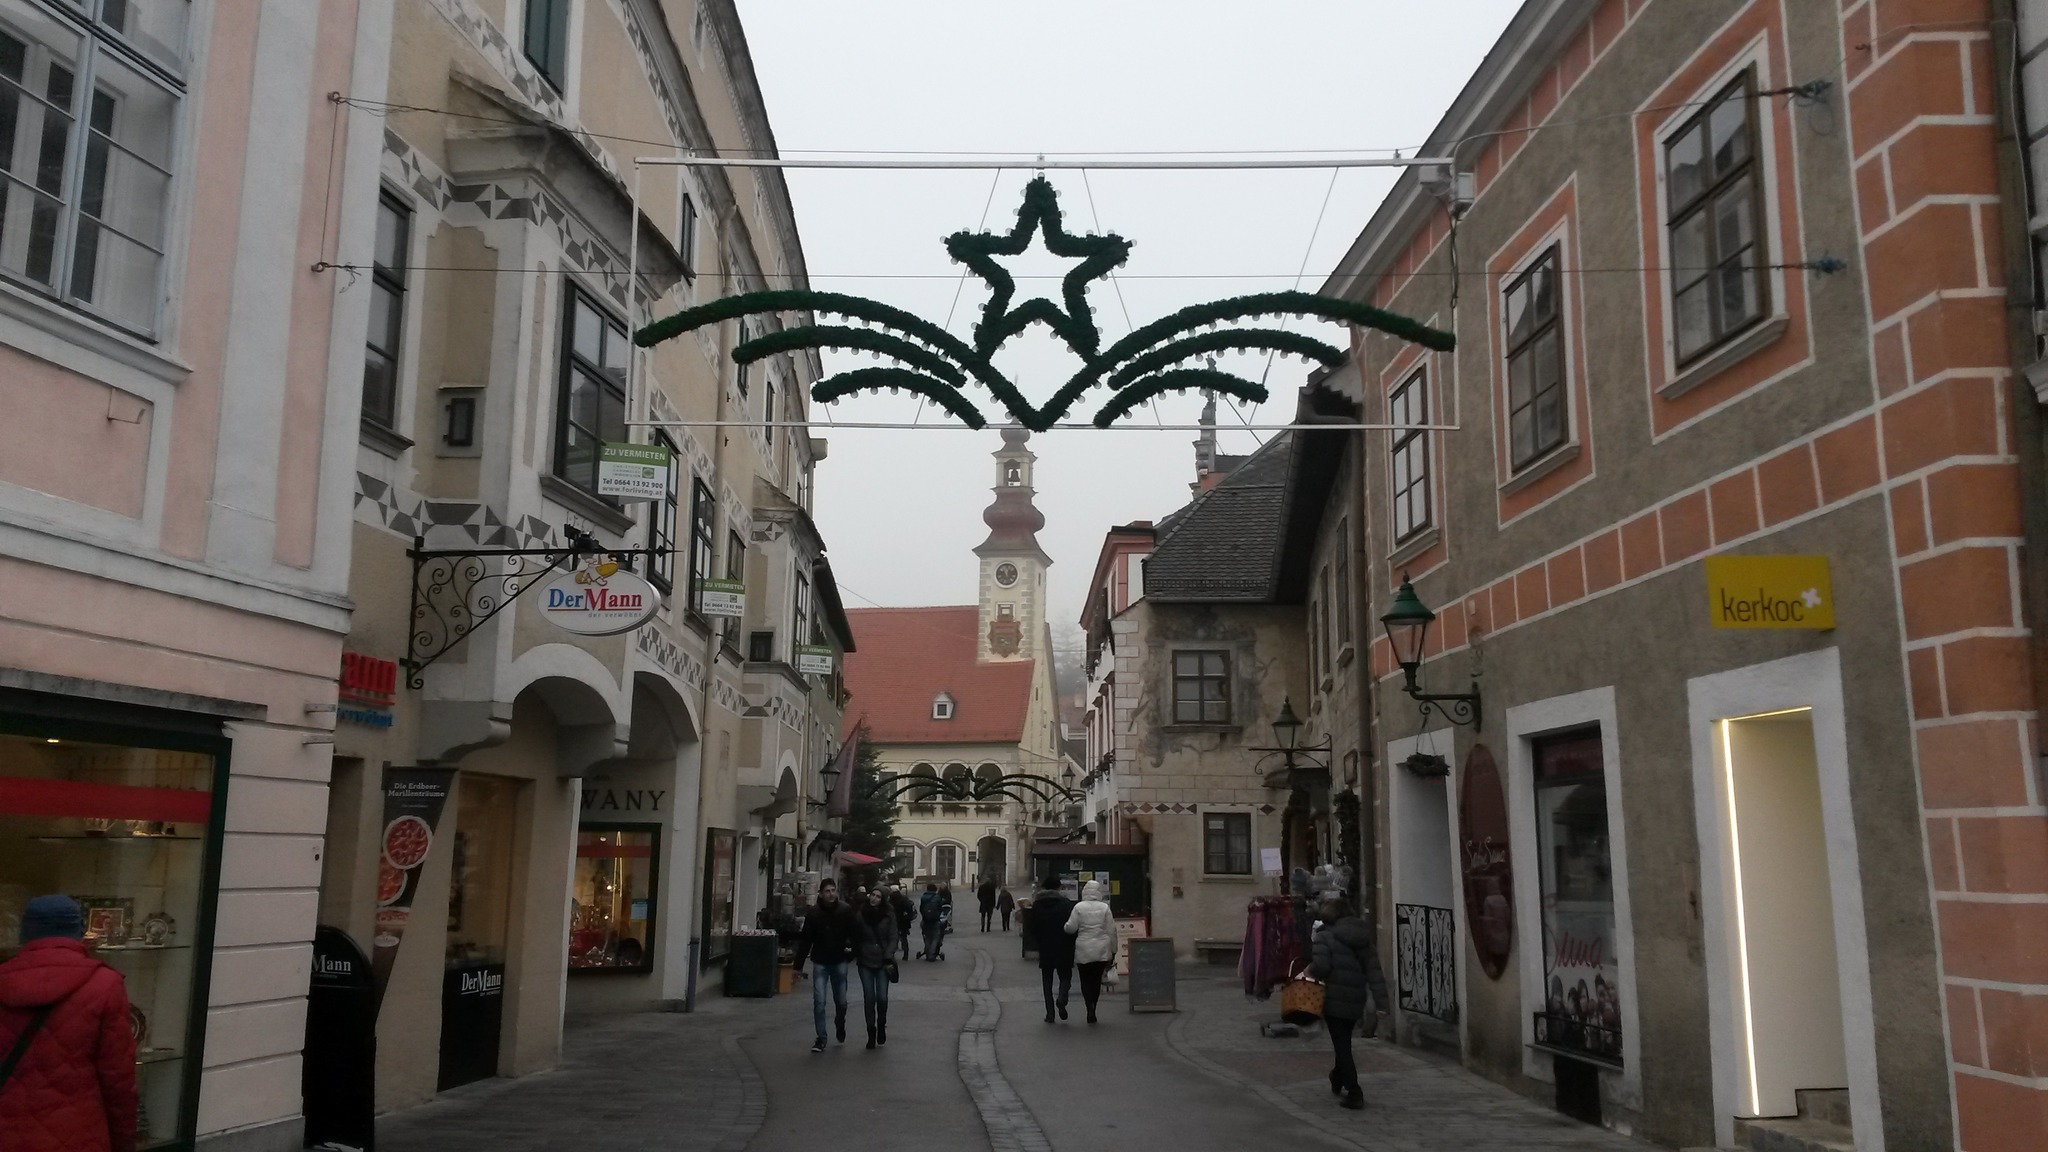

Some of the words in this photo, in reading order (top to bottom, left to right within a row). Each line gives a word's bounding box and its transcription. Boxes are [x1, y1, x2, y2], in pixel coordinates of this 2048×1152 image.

[604, 448, 617, 456] ZU
[618, 449, 666, 460] VERMIETEN
[1721, 588, 1804, 622] kerkoc
[408, 782, 441, 790] Erdbeer-
